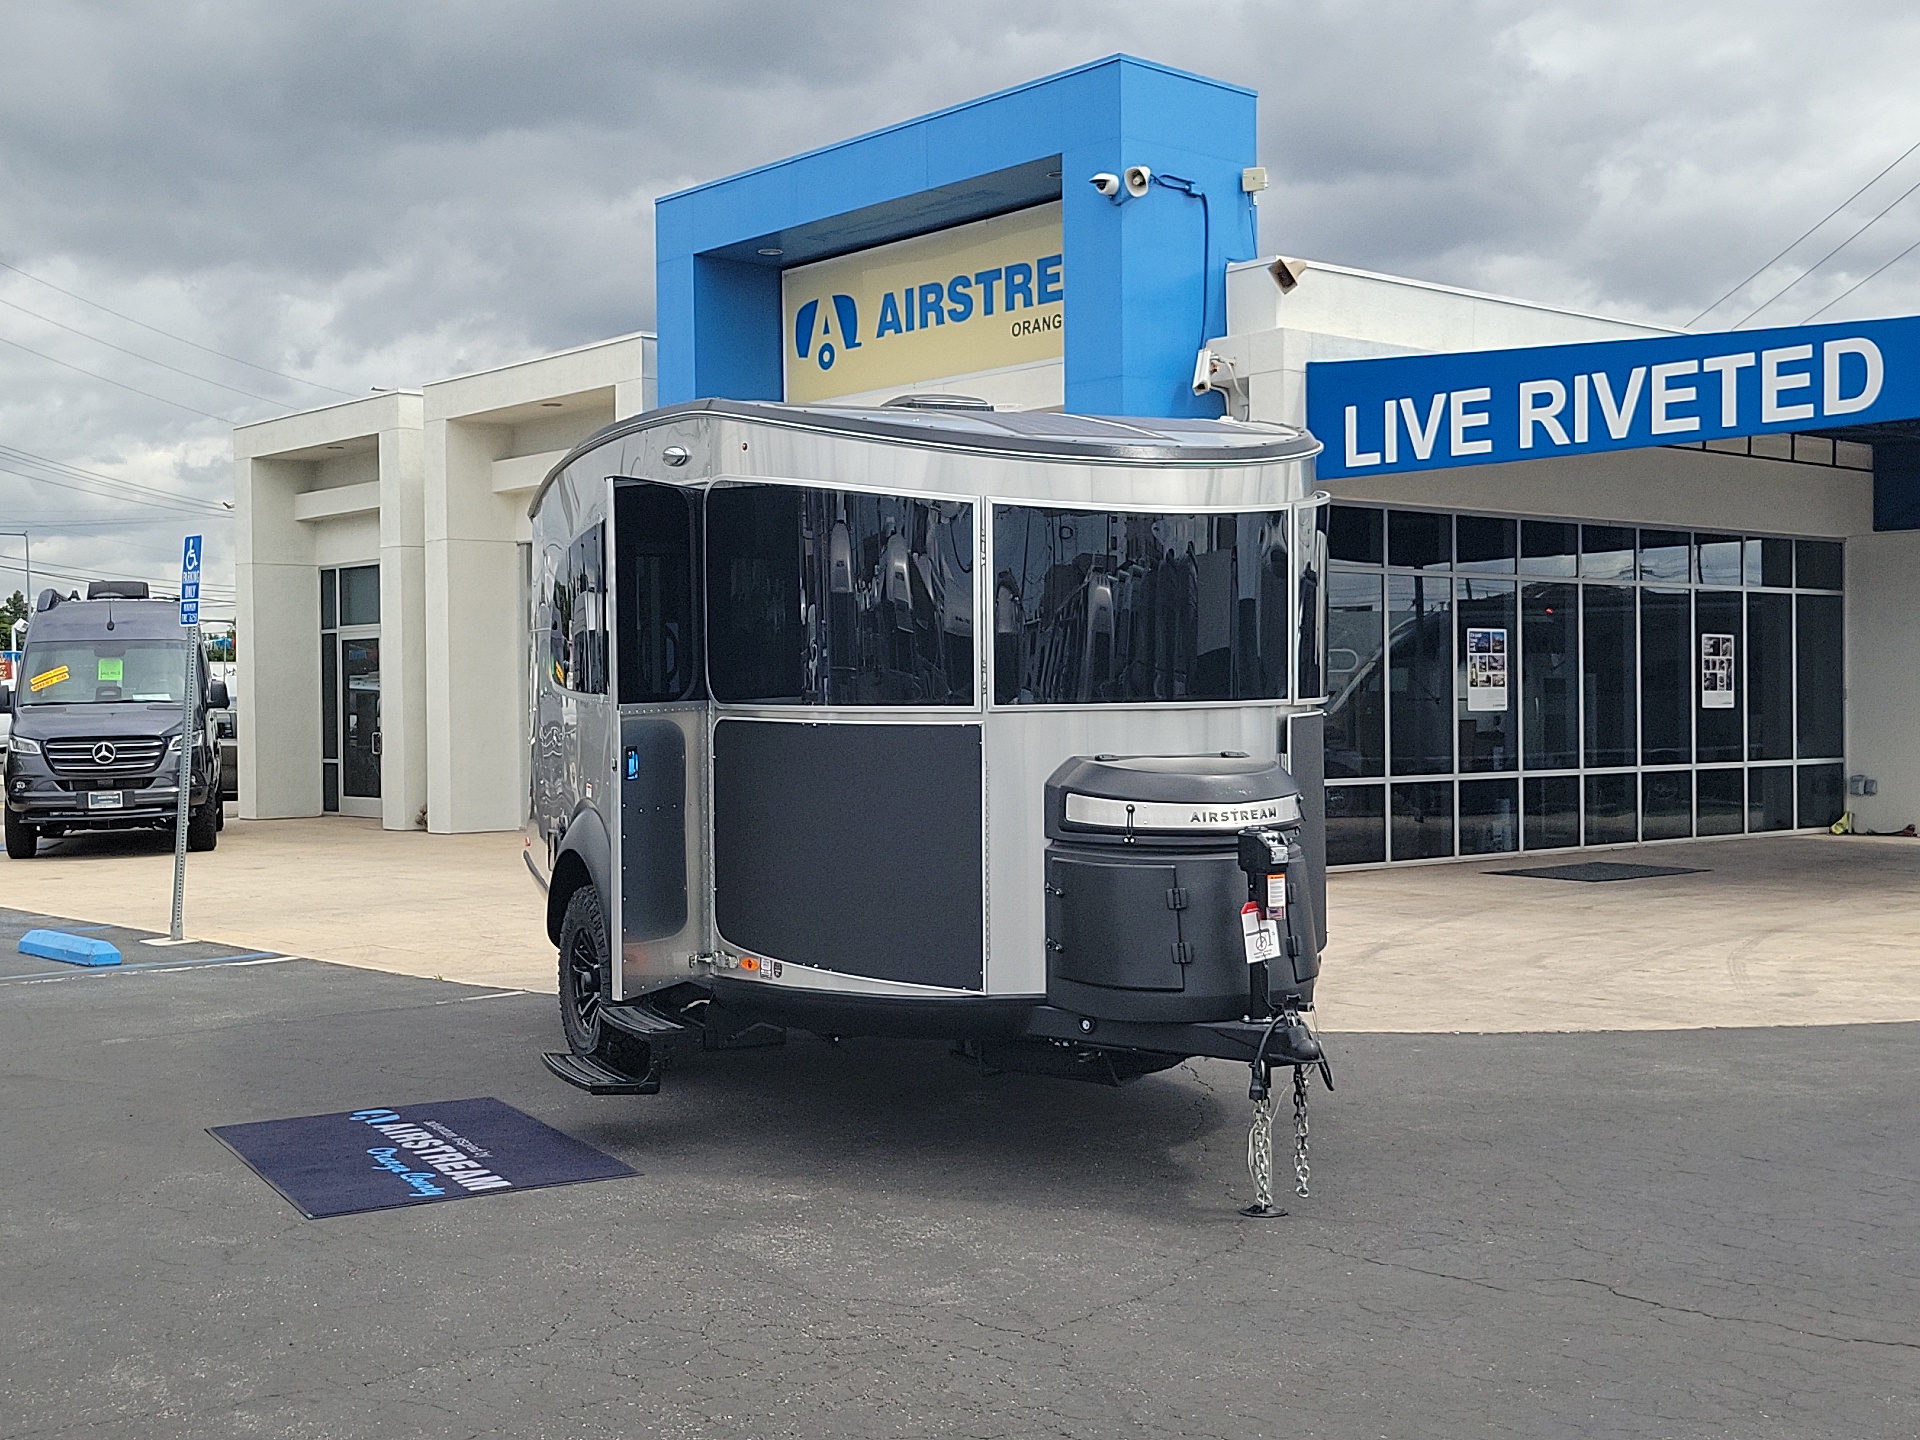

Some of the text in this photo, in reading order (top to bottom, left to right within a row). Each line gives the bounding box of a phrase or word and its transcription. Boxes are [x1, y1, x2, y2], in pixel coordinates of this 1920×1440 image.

[1011, 313, 1063, 338] ORANG
[1344, 337, 1885, 469] LIVE RIVETED
[1190, 807, 1277, 823] AIRSTREAM
[372, 1122, 513, 1192] AIRSTREAM
